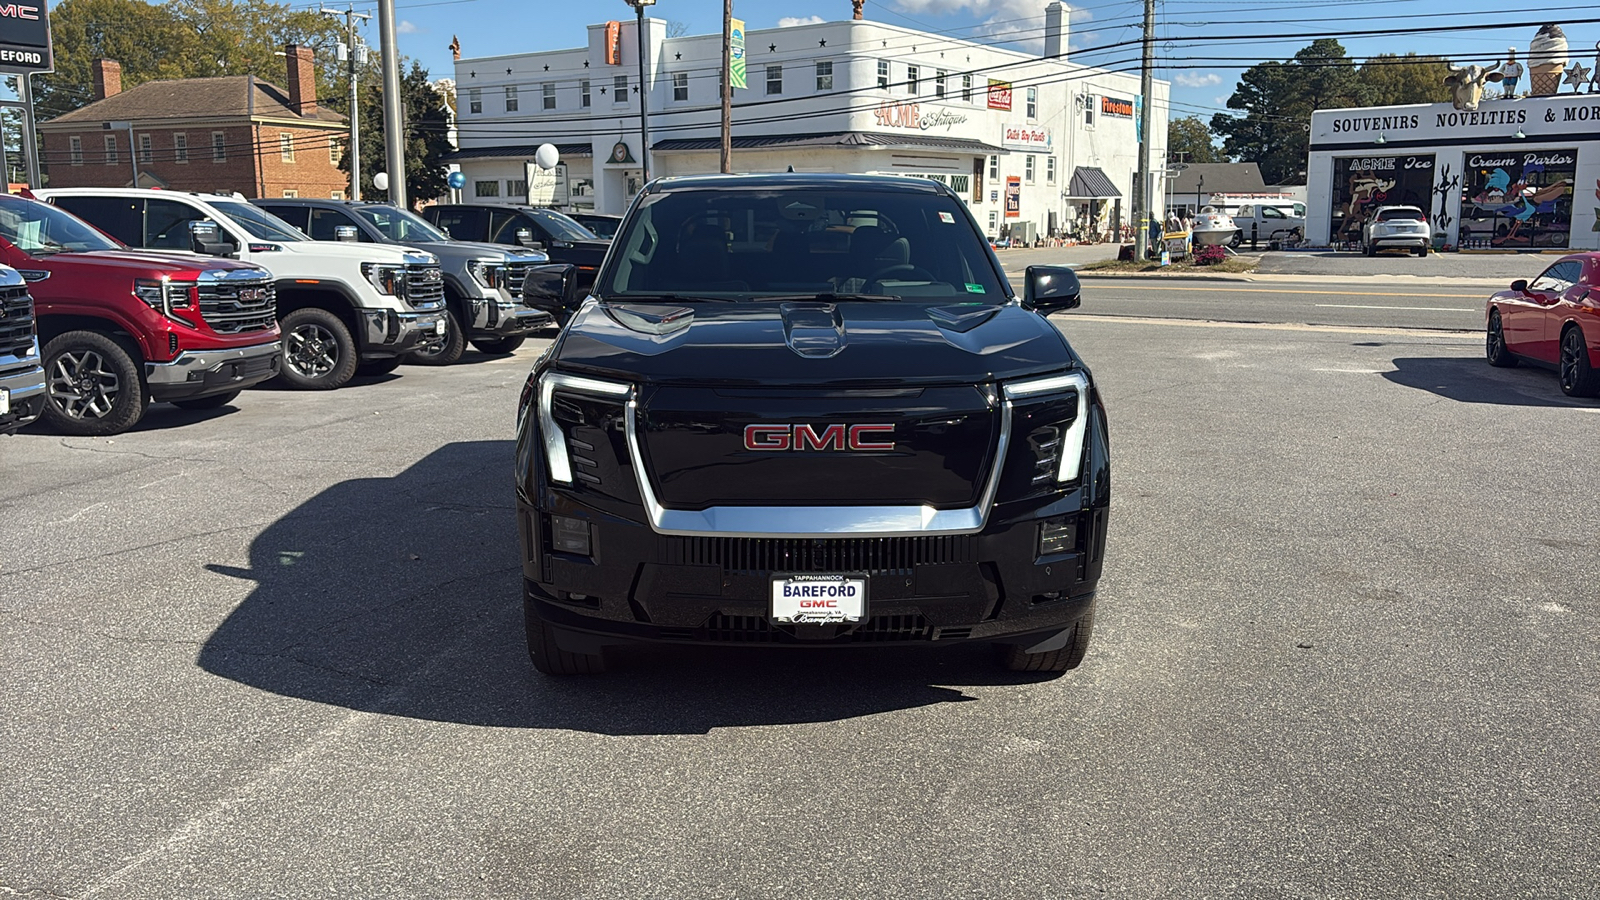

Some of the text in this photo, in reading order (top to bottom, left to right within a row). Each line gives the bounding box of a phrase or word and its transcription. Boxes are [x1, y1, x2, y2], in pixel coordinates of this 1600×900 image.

[1102, 96, 1132, 115] Firestone
[874, 100, 920, 129] ACME
[1333, 115, 1419, 133] SOUVENIRS
[1436, 109, 1527, 127] NOVELTIES
[1544, 108, 1556, 123] &
[1006, 128, 1045, 143] Dutch Boy Paints
[1349, 157, 1433, 171] ACME Ice
[1469, 153, 1574, 168] Cream Parlor
[743, 423, 896, 451] GMC
[783, 586, 856, 597] BAREFORD
[799, 600, 838, 608] GMC
